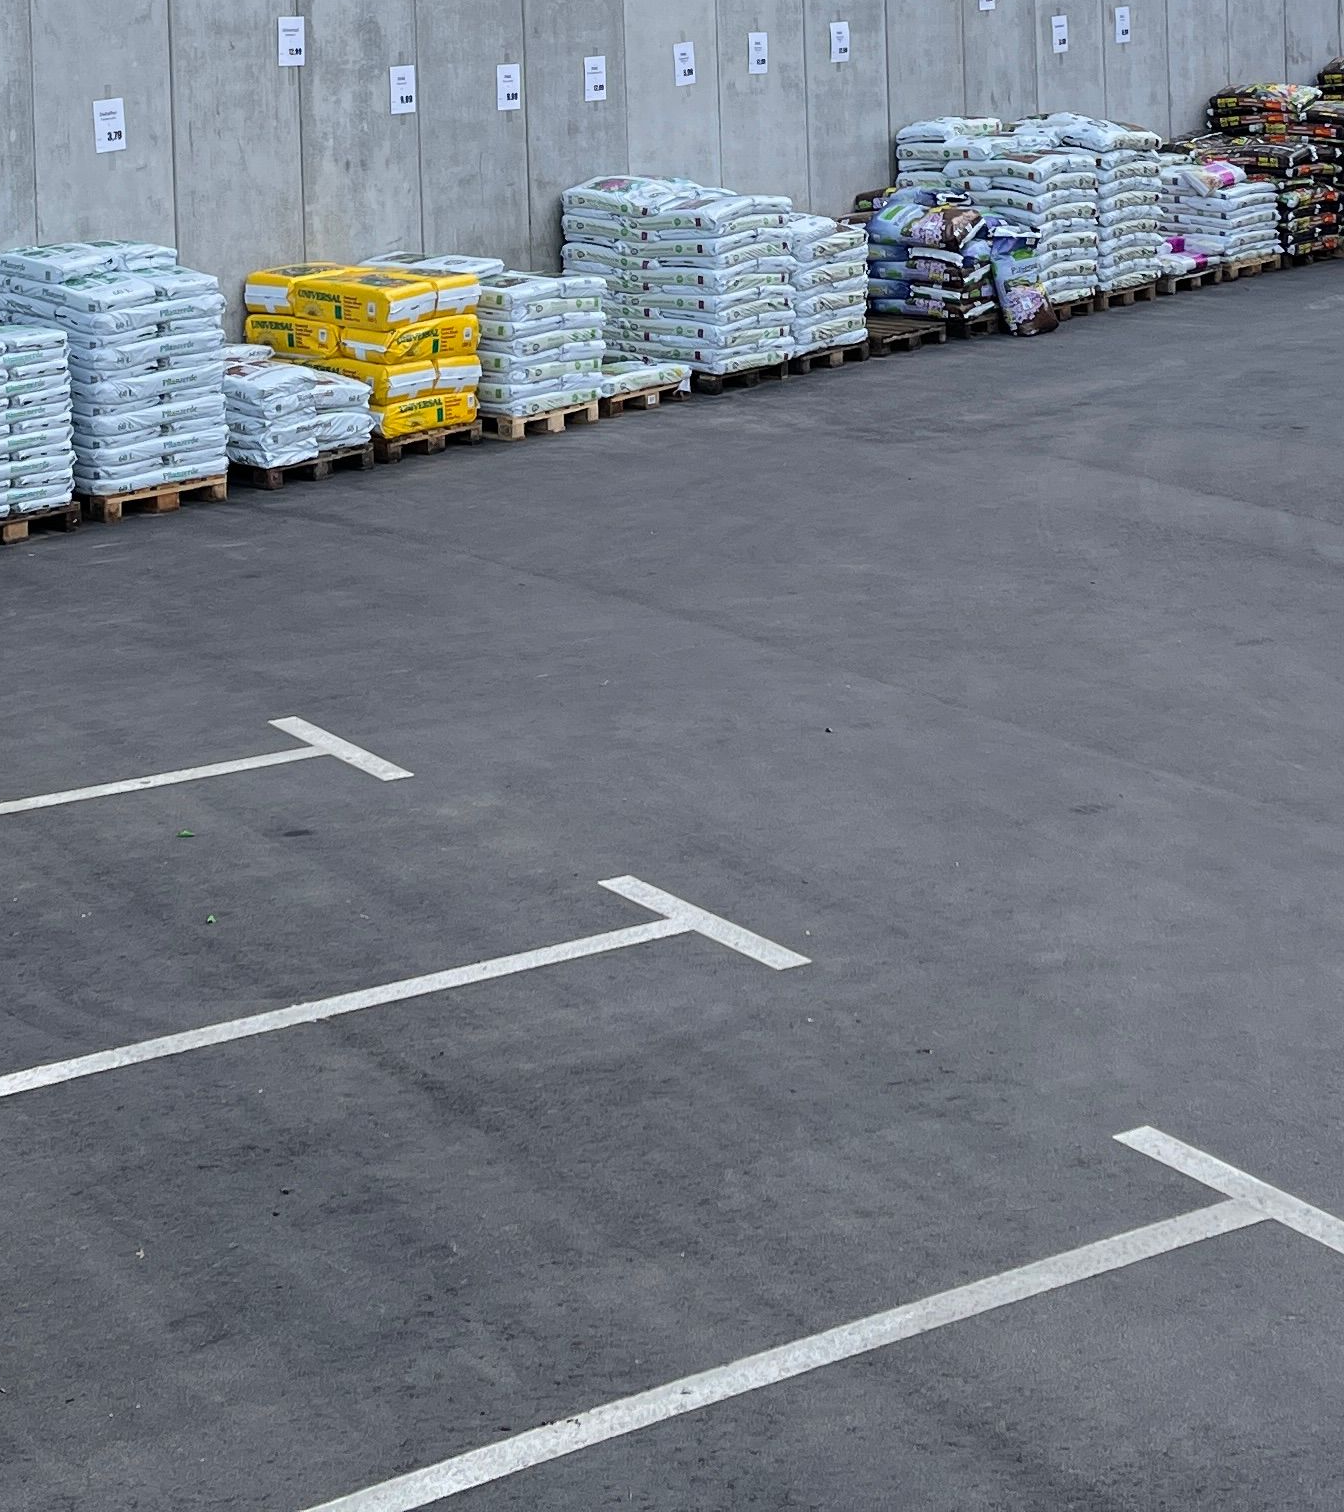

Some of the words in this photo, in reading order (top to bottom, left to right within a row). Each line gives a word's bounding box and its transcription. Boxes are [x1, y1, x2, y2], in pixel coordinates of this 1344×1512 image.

[297, 289, 342, 304] UNIVERSAL
[251, 320, 294, 331] UNIVERSAL
[162, 374, 198, 387] Pflanzerde
[161, 405, 198, 418] Pflanzerde
[399, 397, 443, 414] UNIVERSAL
[163, 436, 199, 449] Pflanzerde
